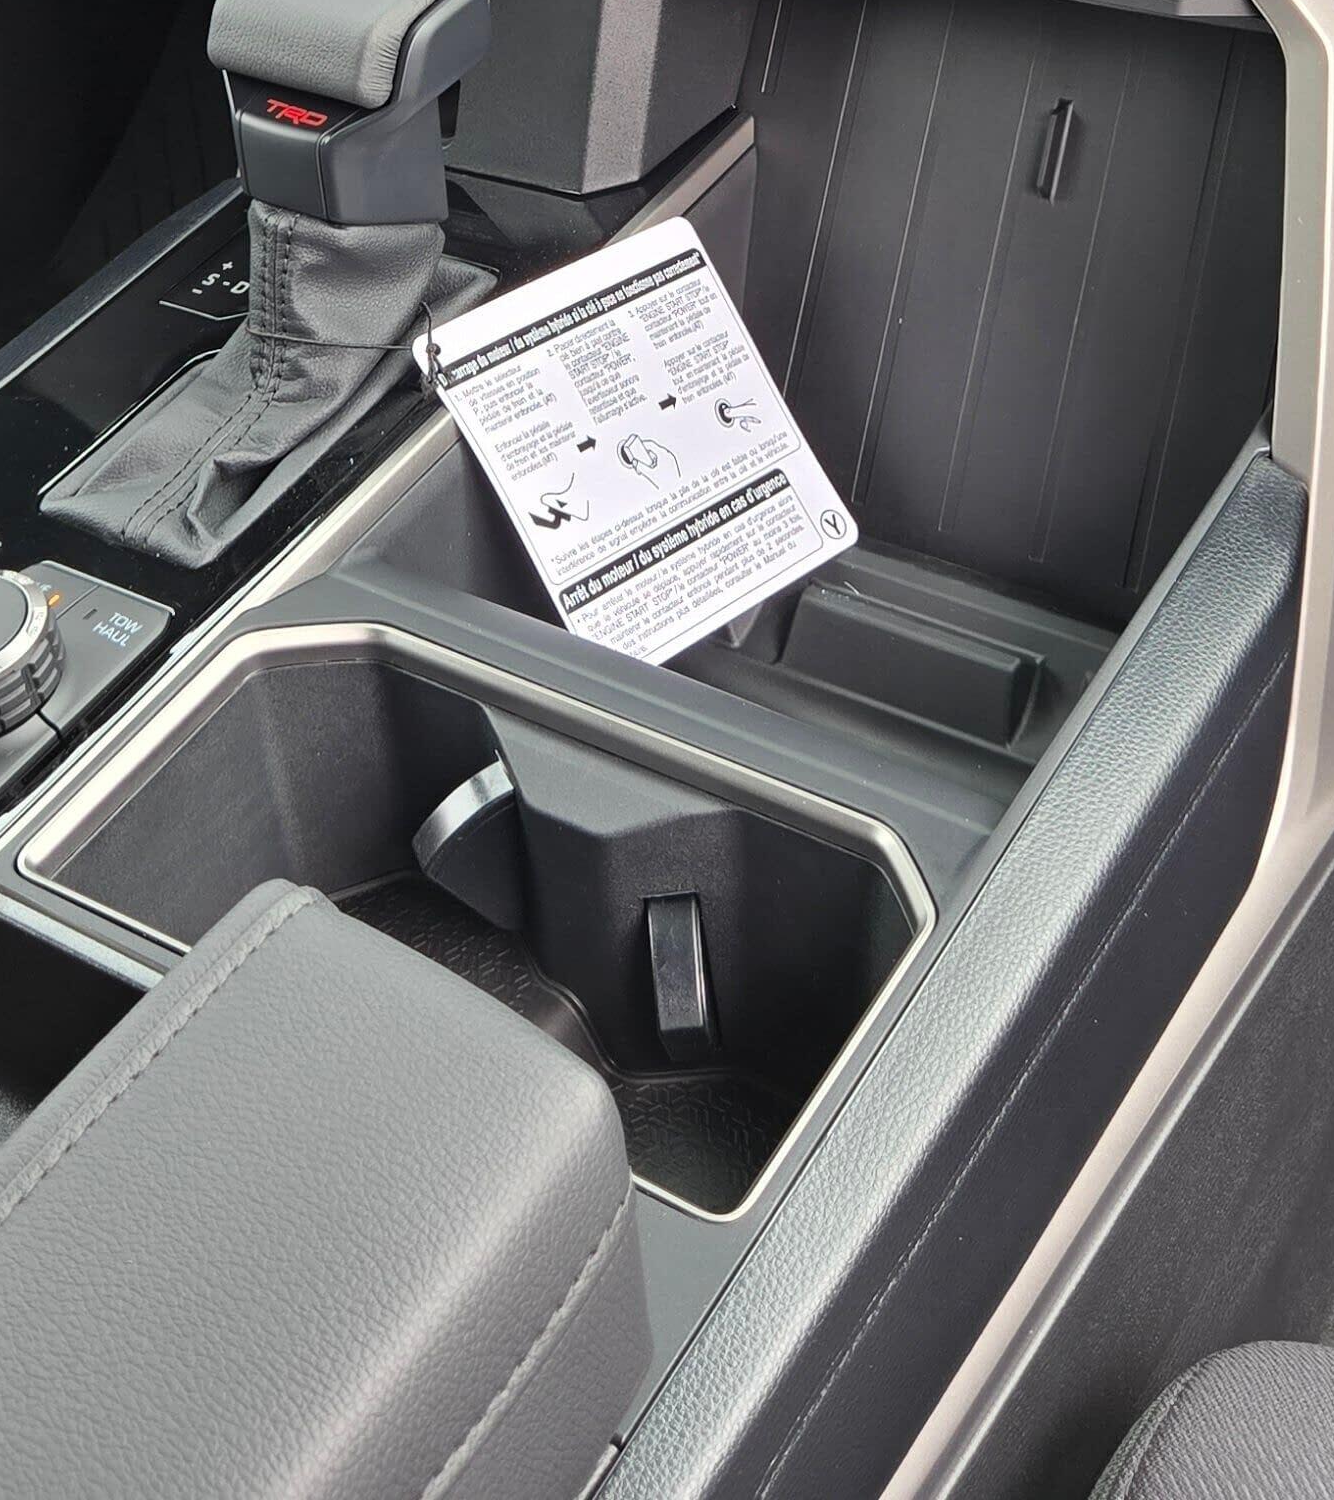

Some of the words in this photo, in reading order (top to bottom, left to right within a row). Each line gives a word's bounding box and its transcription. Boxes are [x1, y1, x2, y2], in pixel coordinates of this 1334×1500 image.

[267, 98, 328, 126] TRD
[825, 516, 843, 536] Y
[560, 583, 589, 608] Arrêt
[586, 576, 602, 594] du
[599, 557, 635, 586] moteur
[636, 547, 653, 565] du
[649, 527, 690, 561] système
[685, 509, 720, 540] hybride
[718, 505, 731, 519] en
[730, 496, 747, 512] cas
[744, 471, 787, 505] d'urgence
[91, 622, 134, 648] HAUL
[107, 611, 143, 633] TOW
